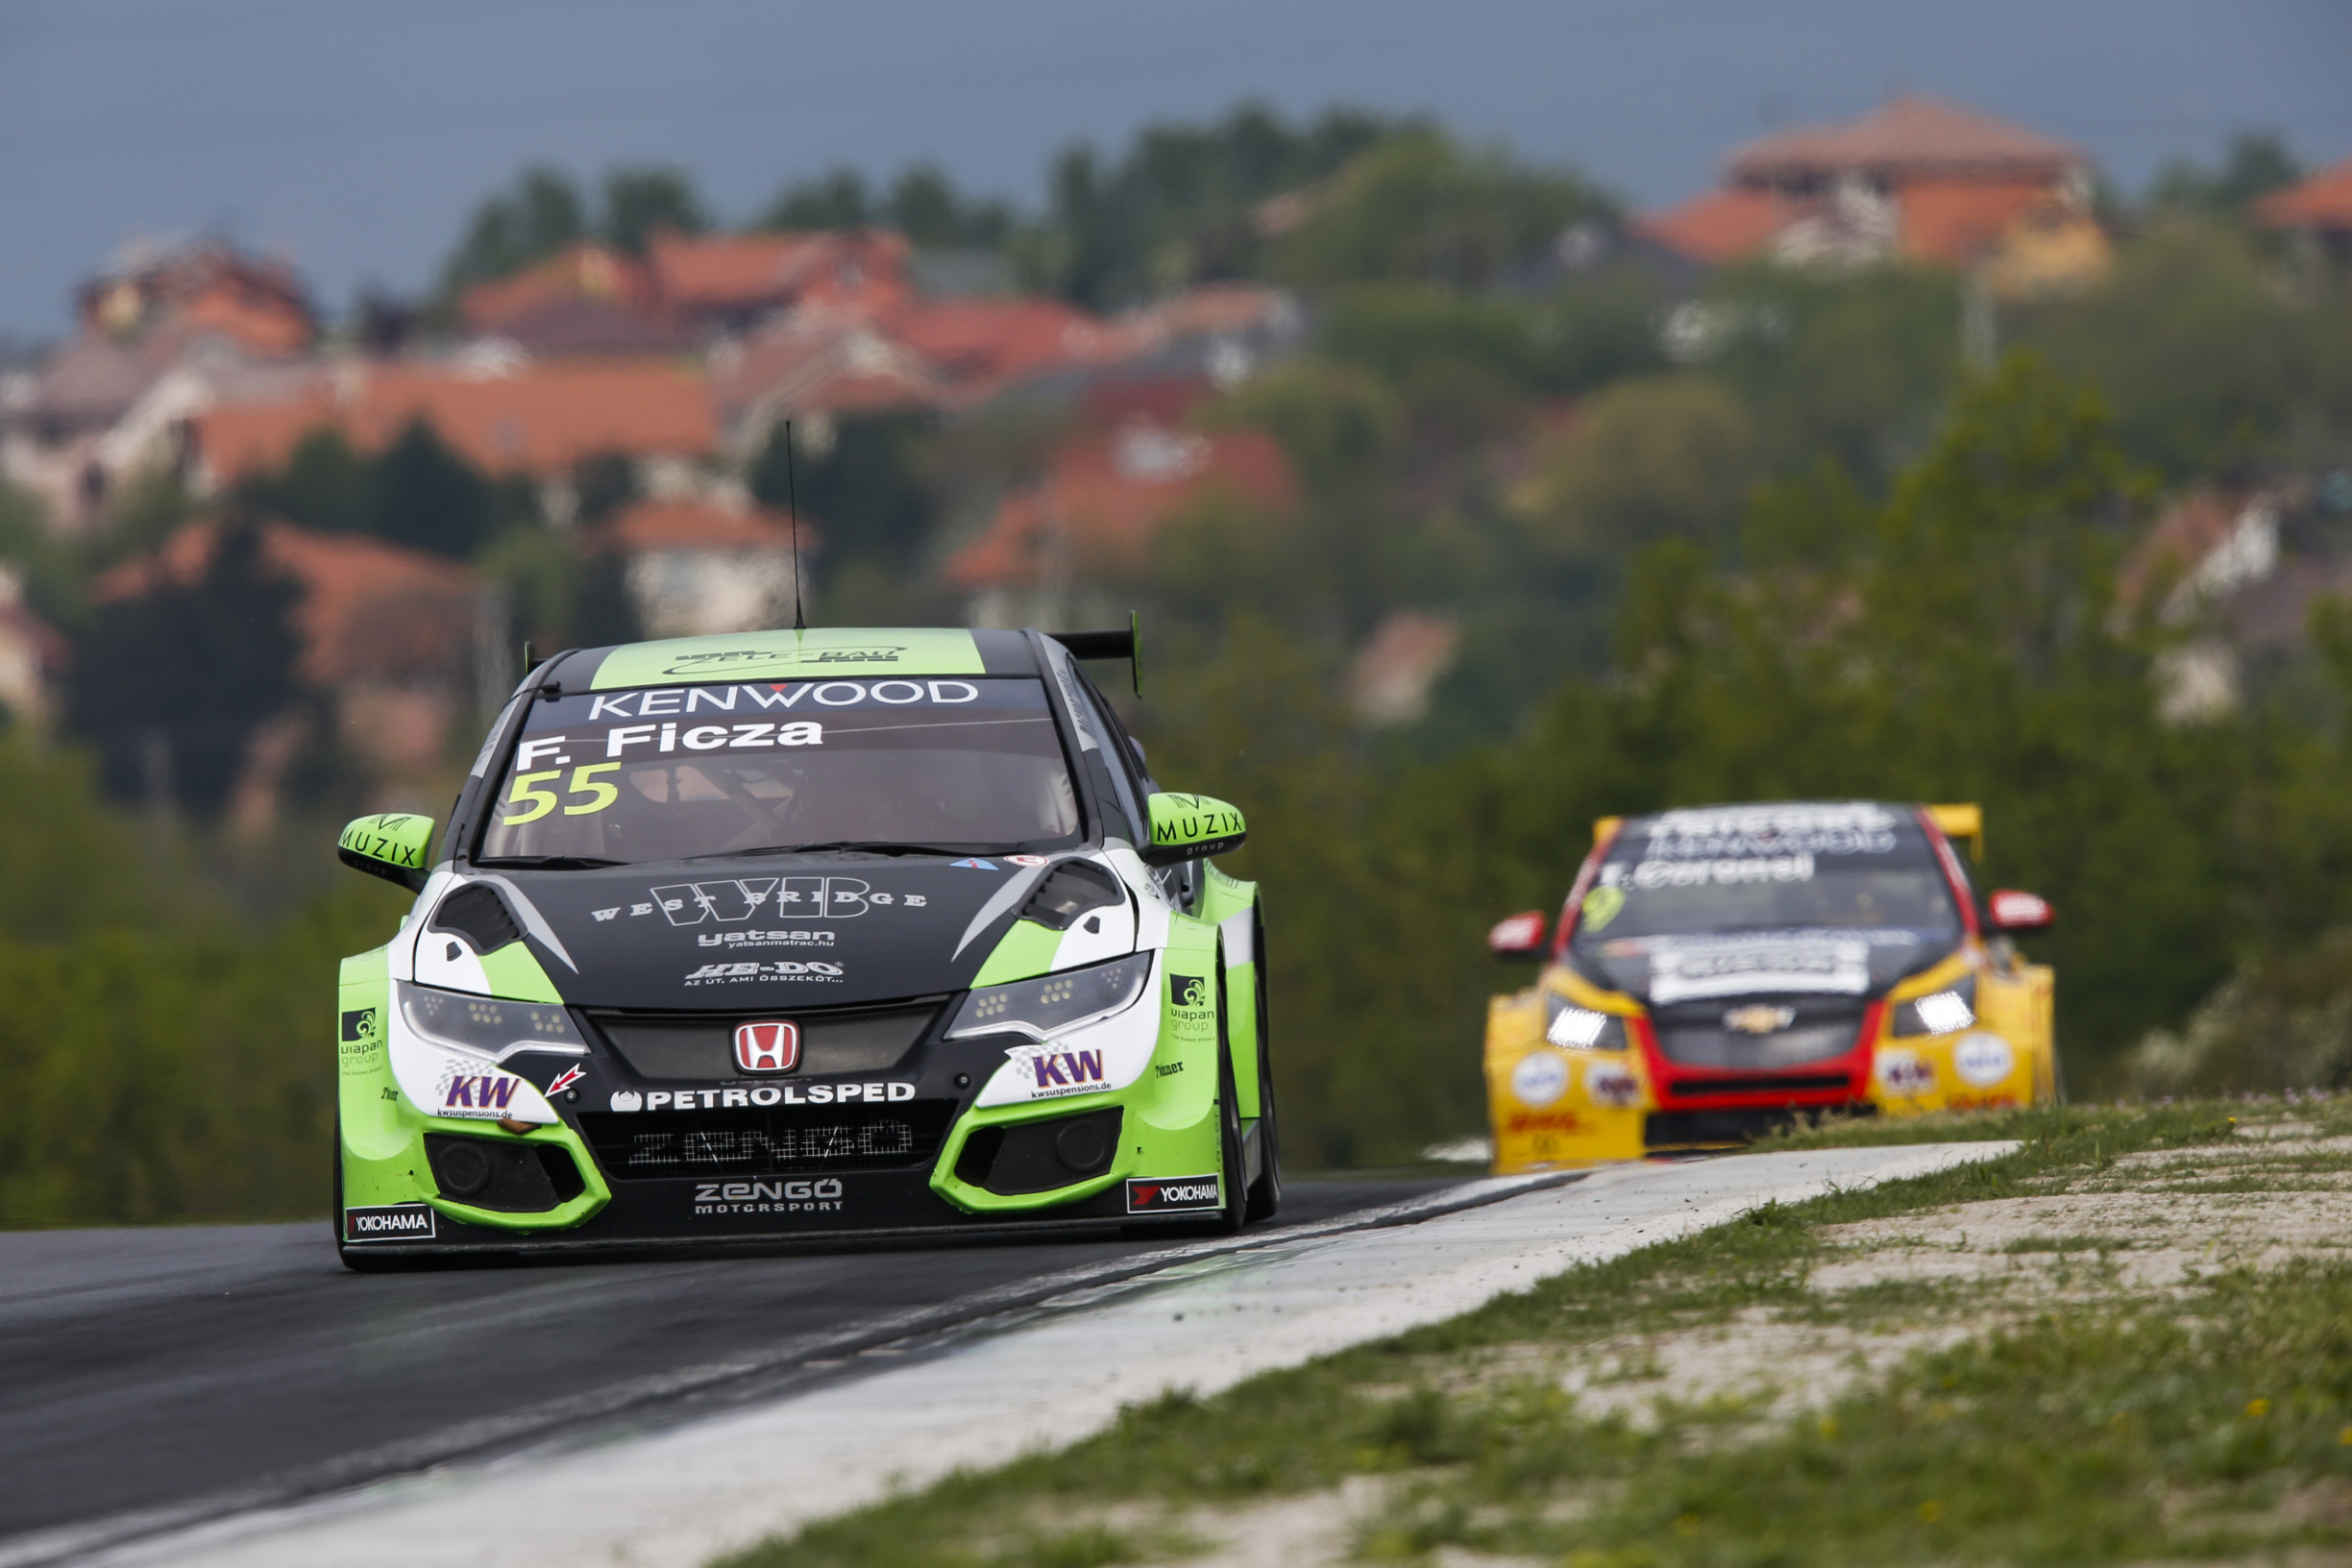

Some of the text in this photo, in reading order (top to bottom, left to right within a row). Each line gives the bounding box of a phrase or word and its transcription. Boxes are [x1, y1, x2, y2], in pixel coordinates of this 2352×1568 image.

[589, 681, 979, 720] KENWOOD
[516, 721, 824, 772] F. Ficza
[503, 761, 622, 826] 55
[1157, 812, 1242, 842] MUZIX
[340, 828, 416, 867] MUZIX
[1187, 842, 1225, 855] group
[592, 891, 928, 922] WEST BRIDGE
[698, 930, 836, 947] yatsan
[728, 940, 835, 949] yatsanmatrac.hu
[1171, 1019, 1209, 1033] group
[1032, 1049, 1105, 1090] KW
[445, 1075, 522, 1109] KW
[647, 1082, 917, 1112] PETROLSPED
[1031, 1083, 1113, 1099] kwsuspensions.de
[437, 1108, 514, 1119] kwsuspensions.de
[1160, 1184, 1219, 1202] YOKOHAMA
[695, 1201, 844, 1215] MOTORSPORT
[355, 1213, 429, 1232] YOKOHAMA
